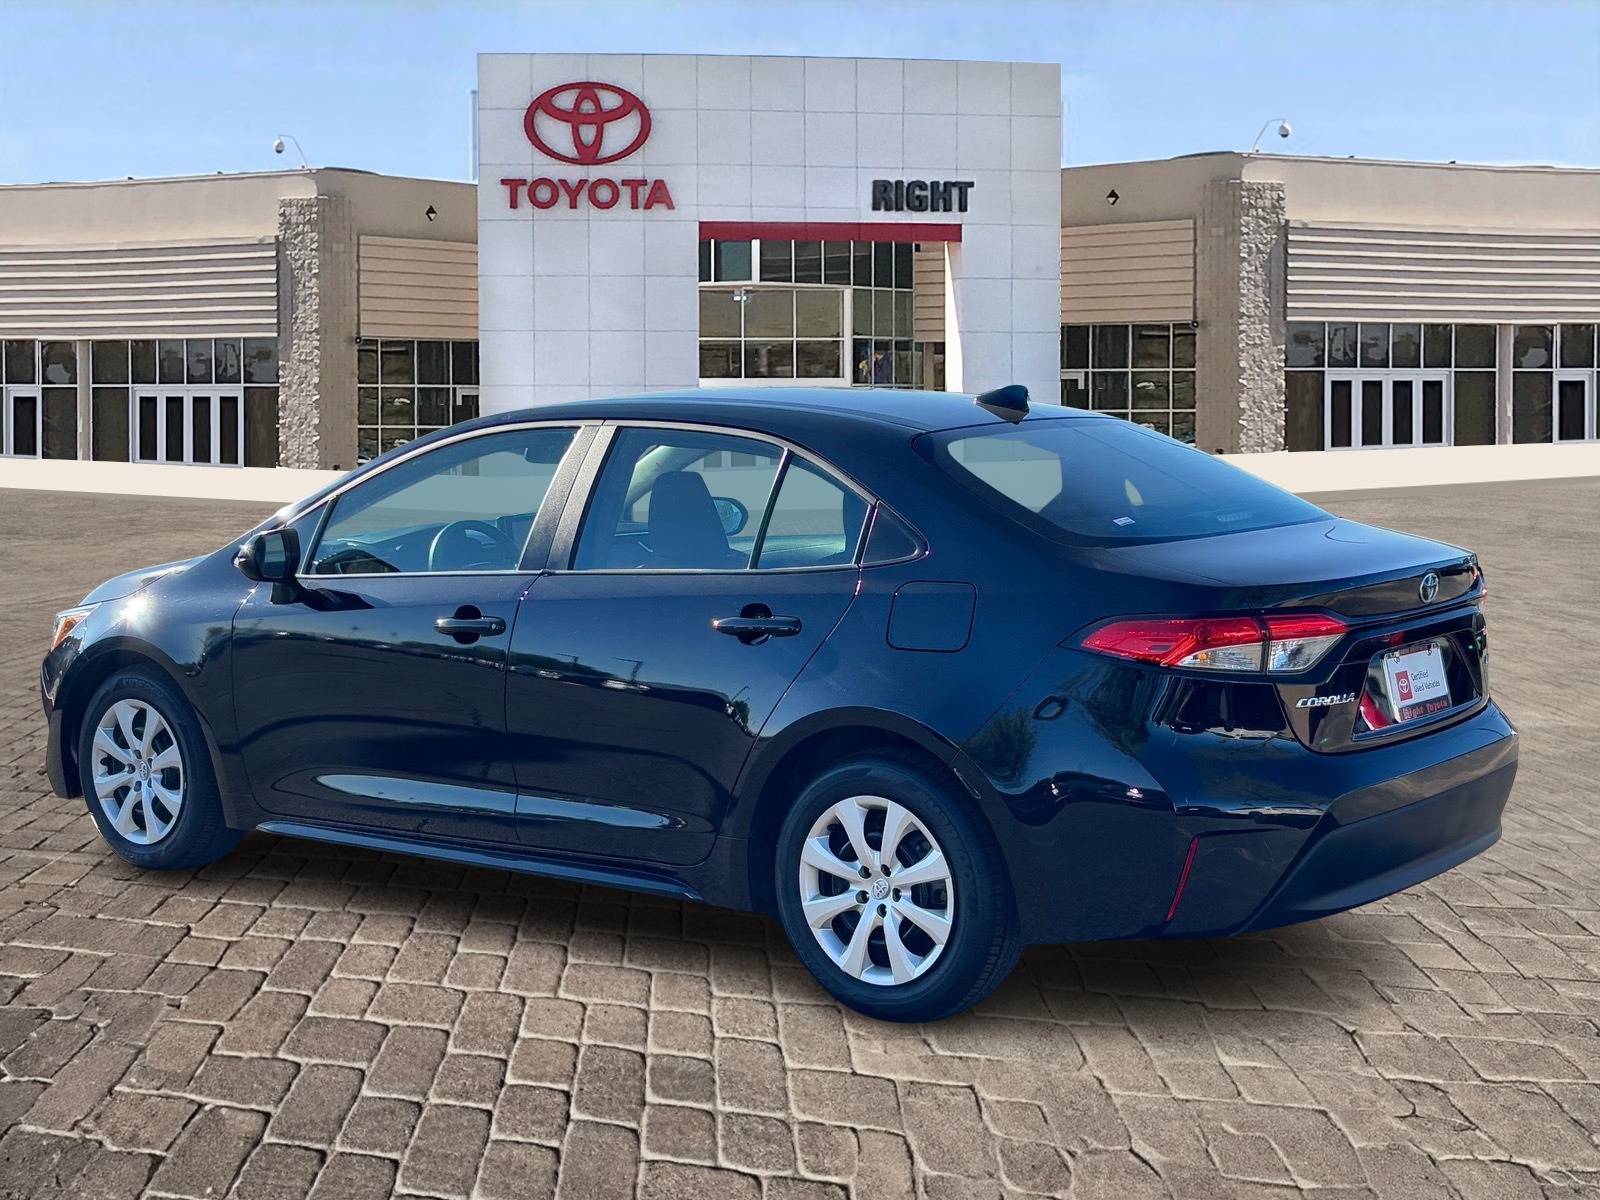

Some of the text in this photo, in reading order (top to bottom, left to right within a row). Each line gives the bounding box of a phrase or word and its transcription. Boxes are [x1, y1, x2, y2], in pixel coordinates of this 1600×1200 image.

[500, 178, 675, 210] TOYOTA
[871, 180, 976, 212] RIGHT
[1411, 670, 1429, 681] Certified
[1413, 679, 1441, 693] Used Vehicles
[1295, 692, 1355, 708] COROLLA
[1402, 699, 1448, 719] Right Toyota
